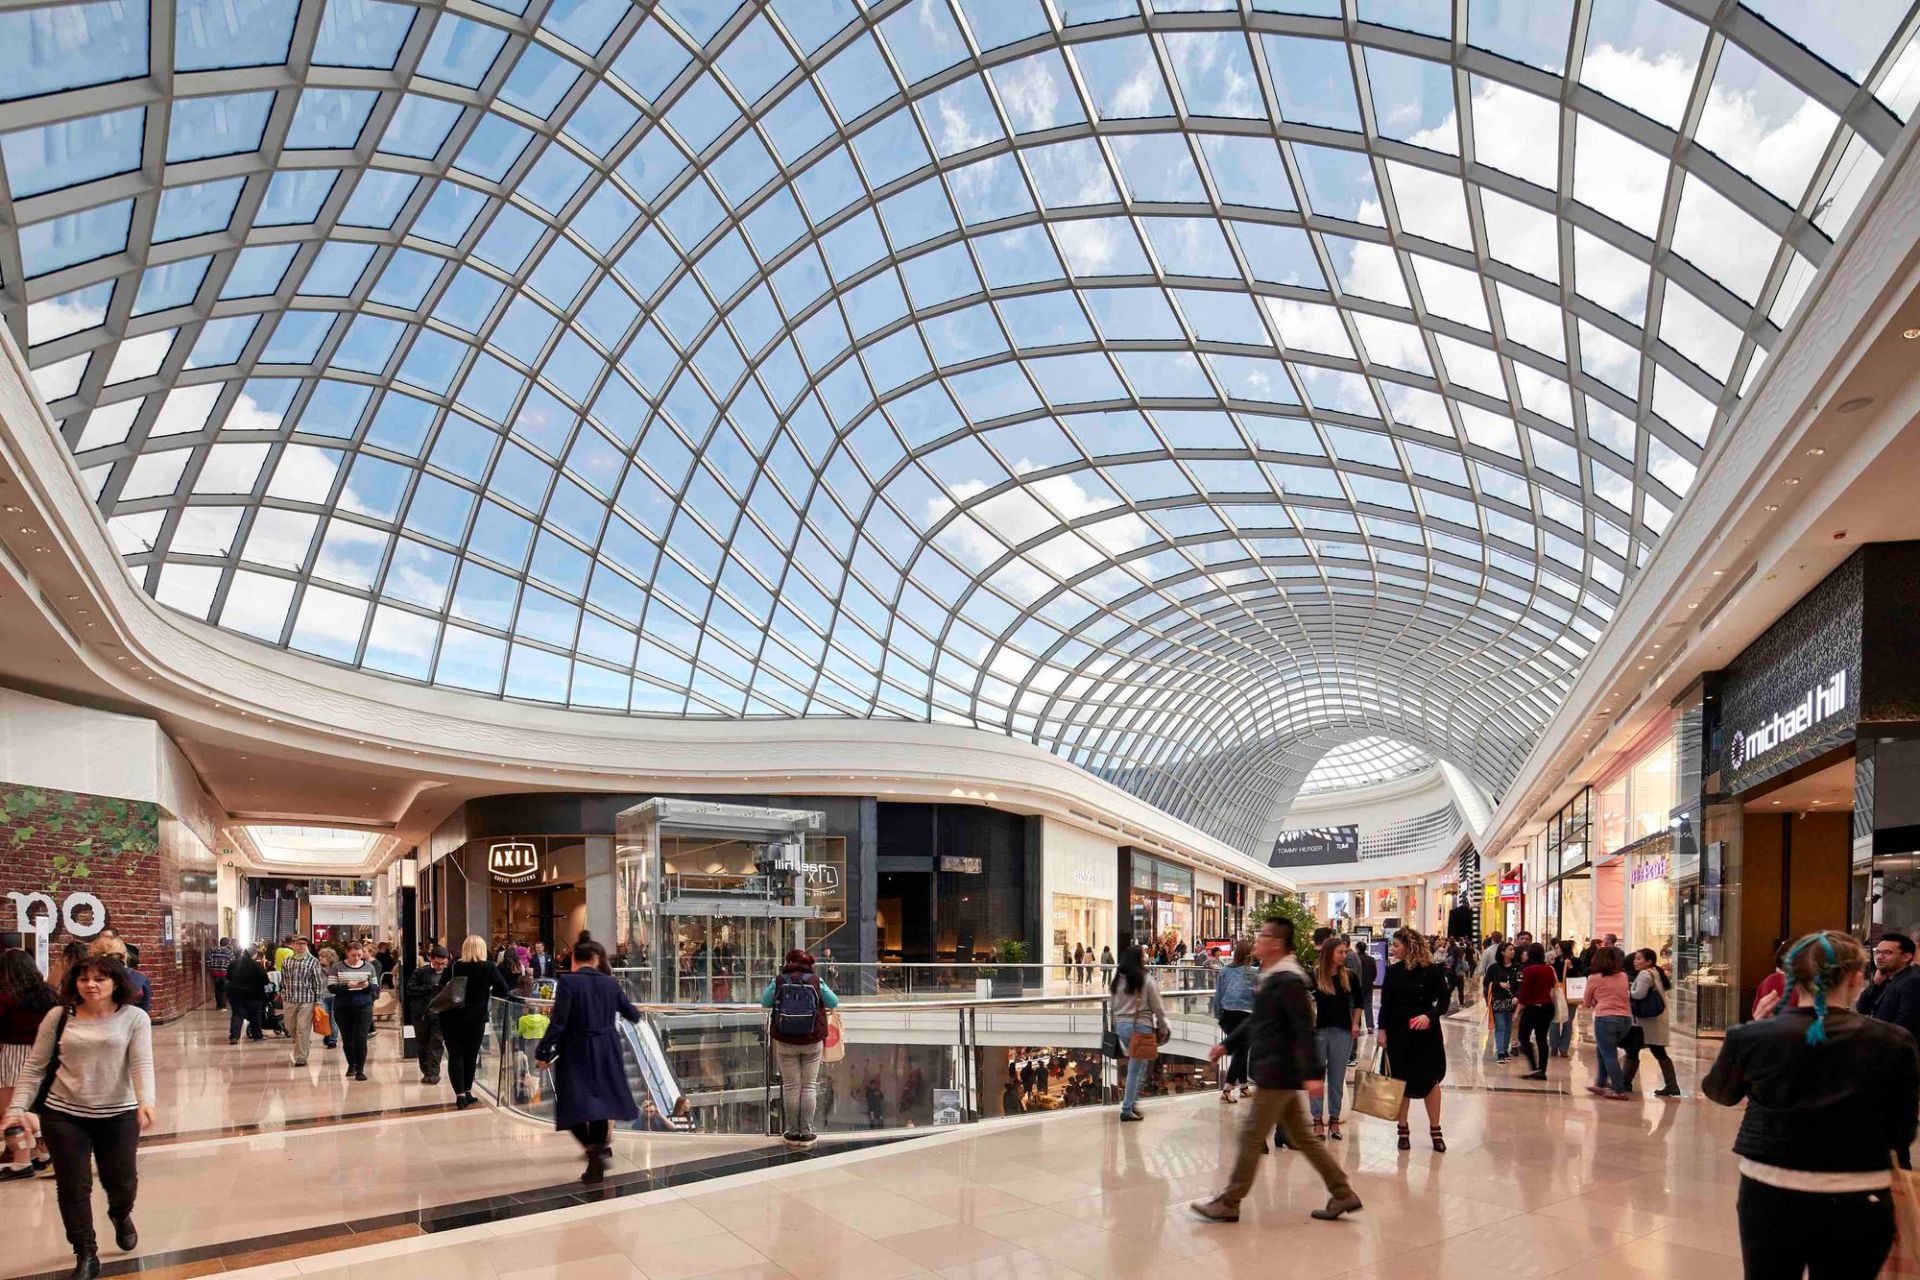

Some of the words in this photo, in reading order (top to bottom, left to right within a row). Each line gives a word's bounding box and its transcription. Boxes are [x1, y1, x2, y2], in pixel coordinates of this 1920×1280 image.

[1745, 689, 1812, 761] michael
[1816, 668, 1846, 723] hill
[1336, 842, 1349, 850] TUMI
[494, 850, 533, 866] AXIL
